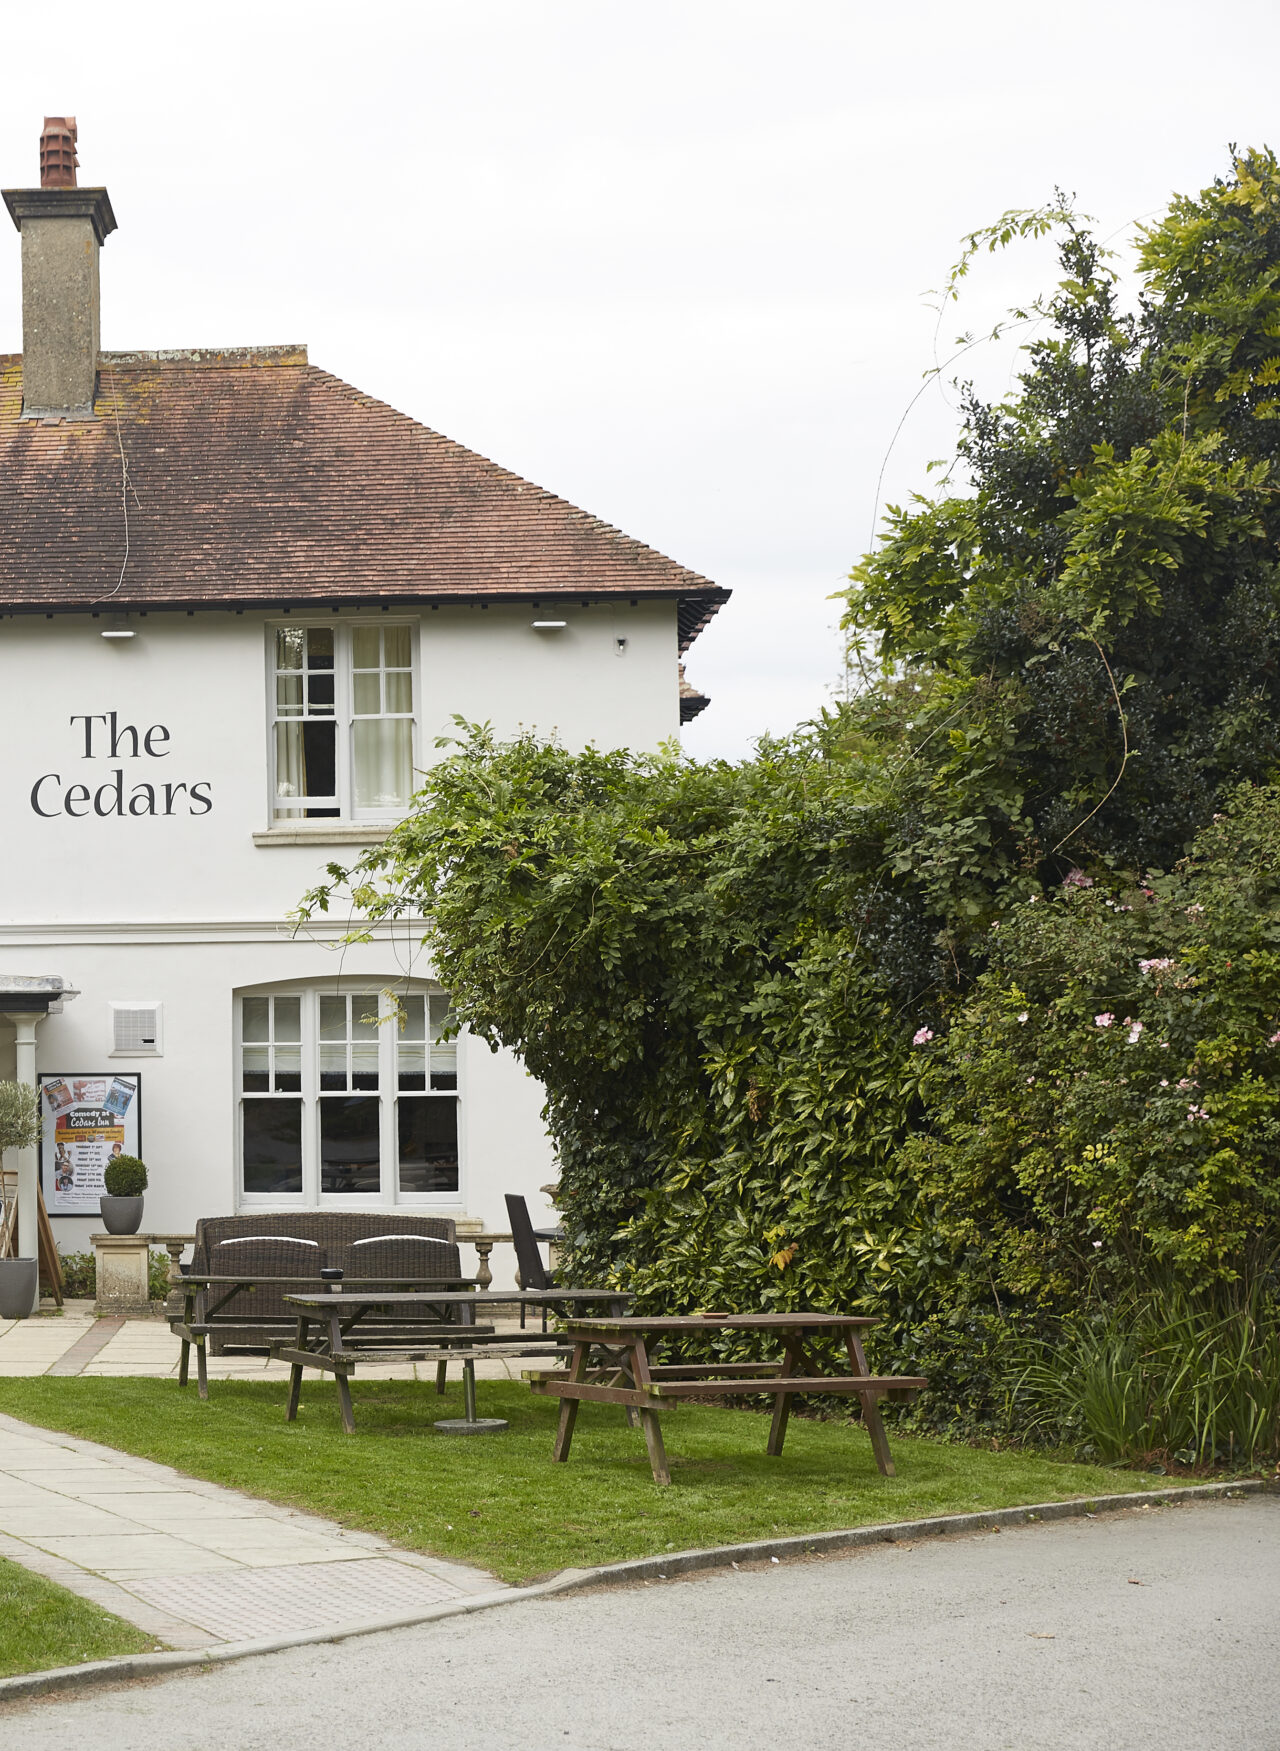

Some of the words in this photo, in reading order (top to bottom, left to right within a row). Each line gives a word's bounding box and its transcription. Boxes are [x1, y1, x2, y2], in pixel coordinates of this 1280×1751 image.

[69, 711, 170, 759] The
[30, 769, 213, 818] Cedars
[69, 1110, 100, 1118] Comedy
[70, 1117, 96, 1127] Cedars
[97, 1116, 110, 1127] Inn
